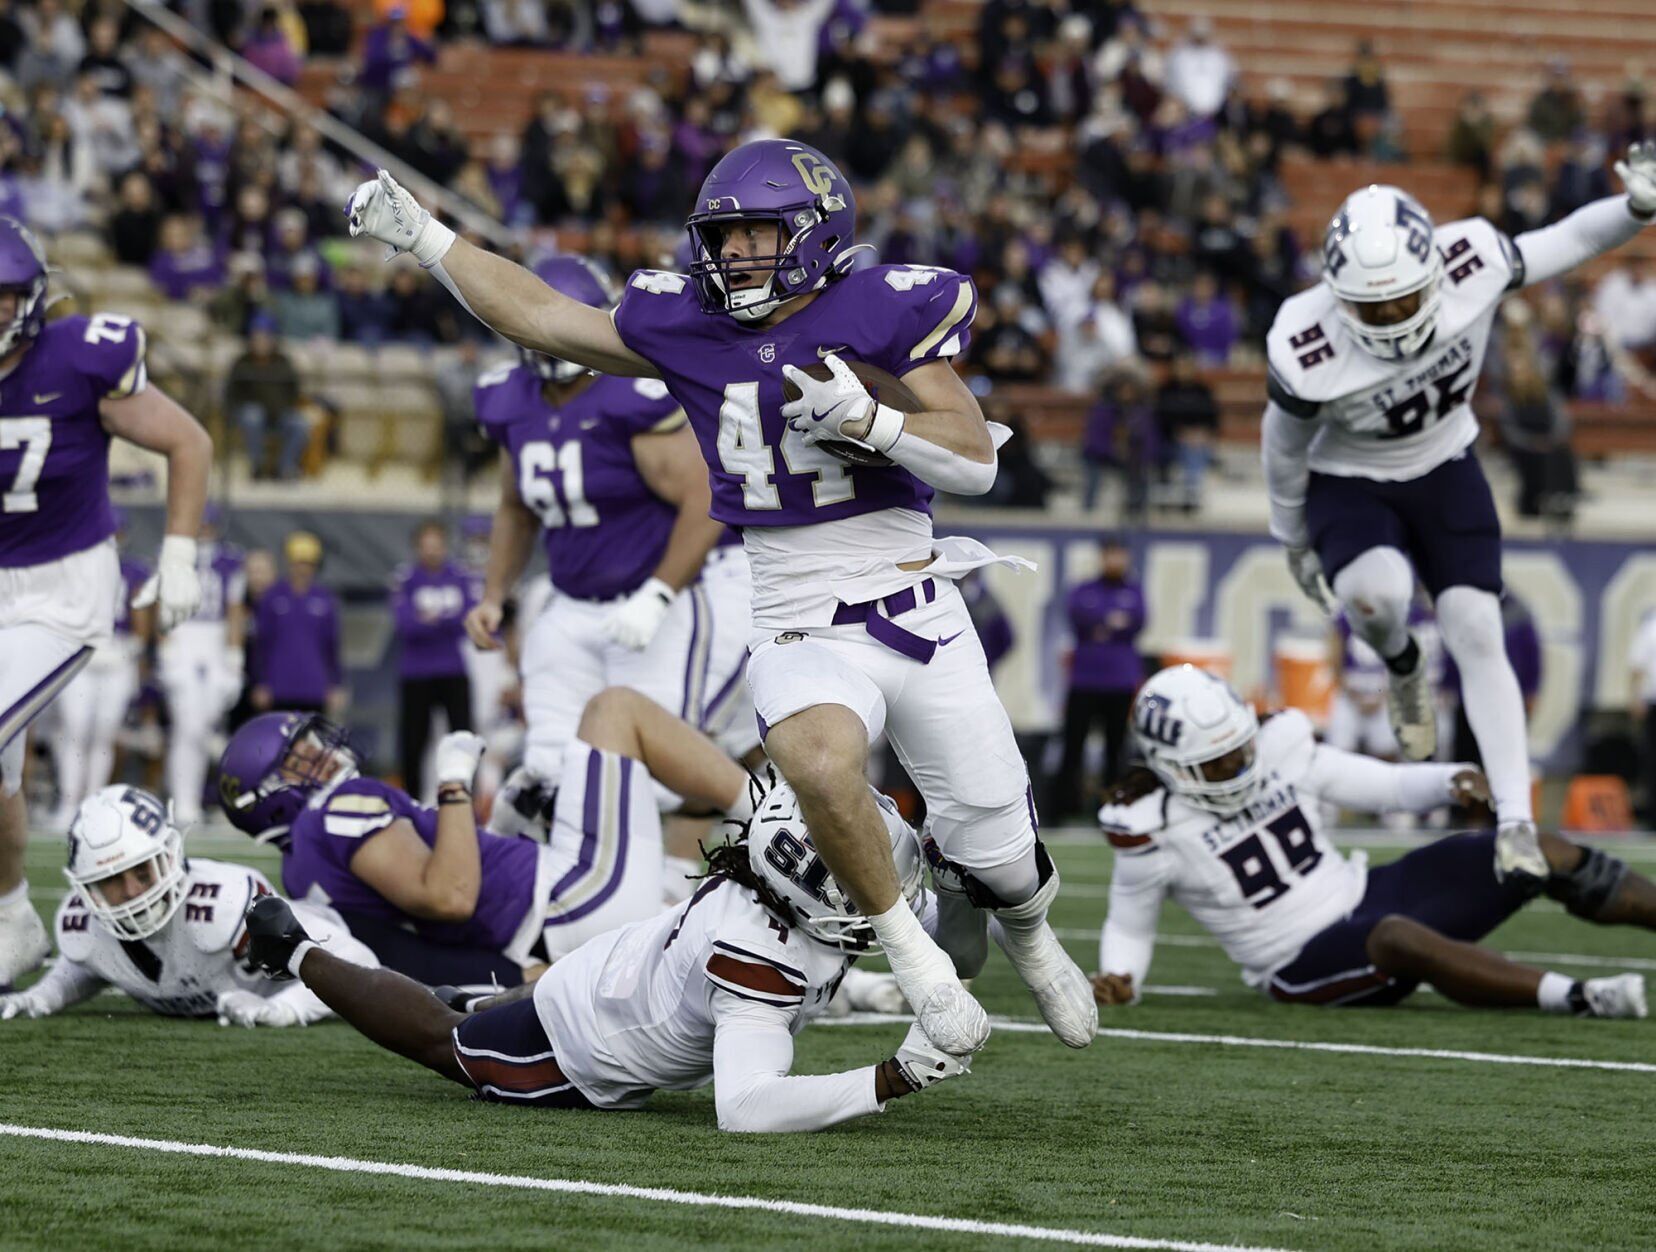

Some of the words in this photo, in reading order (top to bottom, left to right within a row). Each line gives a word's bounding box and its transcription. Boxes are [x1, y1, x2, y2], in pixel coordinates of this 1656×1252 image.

[1288, 322, 1335, 370] 96
[520, 440, 600, 528] 61
[717, 381, 856, 511] 44
[1218, 805, 1323, 911] 99
[185, 882, 222, 923] 33
